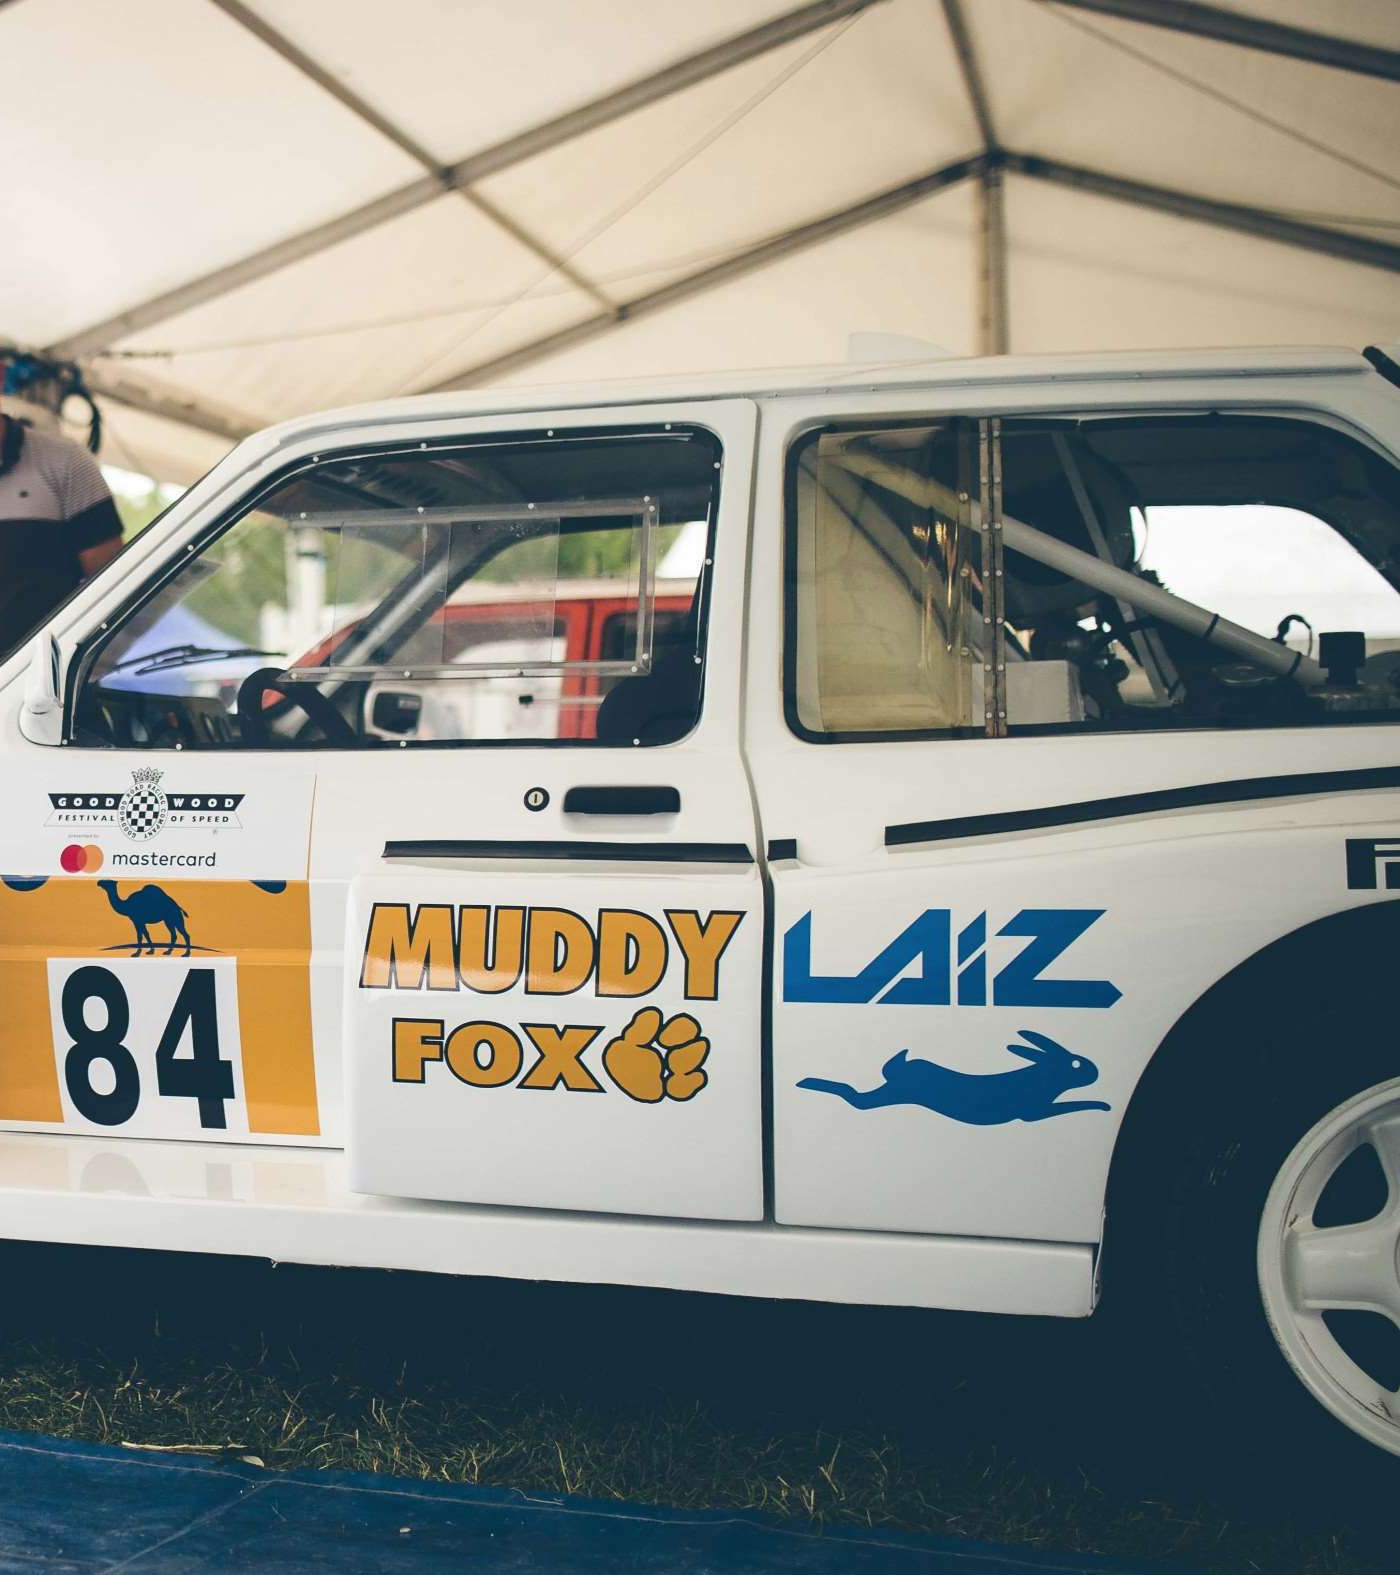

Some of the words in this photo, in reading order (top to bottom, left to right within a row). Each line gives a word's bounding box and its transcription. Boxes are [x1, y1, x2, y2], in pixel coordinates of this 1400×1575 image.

[58, 797, 115, 807] GOOD
[173, 798, 234, 808] WOOD
[58, 814, 115, 822] FESTIVAL
[192, 815, 230, 823] SPEED
[112, 852, 216, 867] mastercard
[358, 902, 748, 1001] MUDDY
[61, 964, 235, 1130] 84
[391, 1017, 607, 1094] FOX
